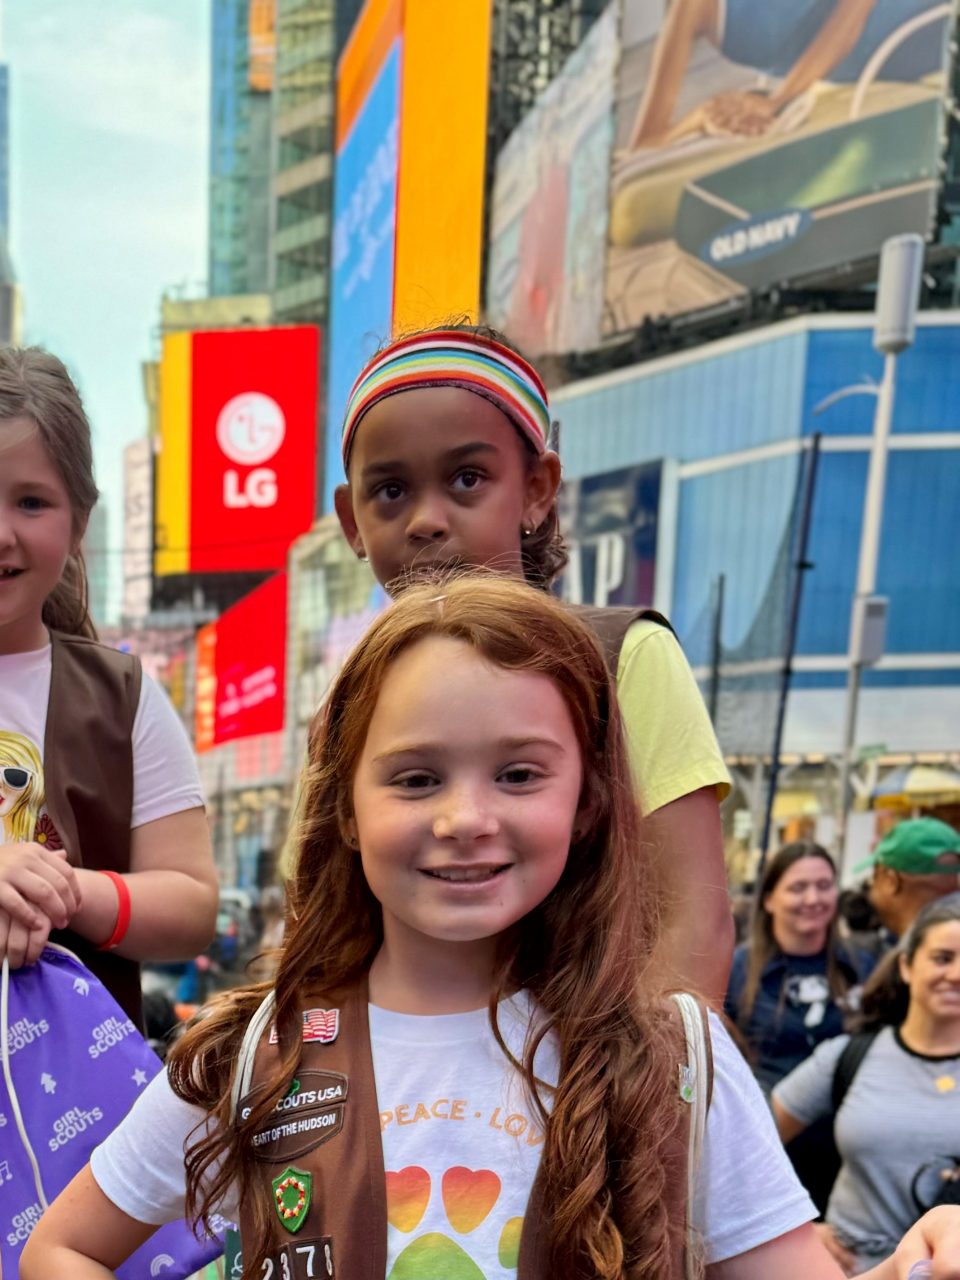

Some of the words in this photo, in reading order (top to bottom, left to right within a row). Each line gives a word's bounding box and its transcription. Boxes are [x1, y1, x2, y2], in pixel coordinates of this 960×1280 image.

[710, 231, 746, 262] OLD
[746, 212, 801, 250] NAVY
[223, 467, 278, 508] LG
[88, 1019, 137, 1059] SCOUTS
[92, 1016, 122, 1040] GIRL
[317, 1085, 342, 1101] USA
[48, 1107, 103, 1151] SCOUTS
[52, 1106, 86, 1133] GIRL
[252, 1130, 272, 1147] EART
[271, 1127, 282, 1140] OF
[280, 1121, 299, 1138] THE
[298, 1113, 336, 1133] HUDSON
[379, 1098, 468, 1132] PEACE
[489, 1106, 546, 1146] LOV
